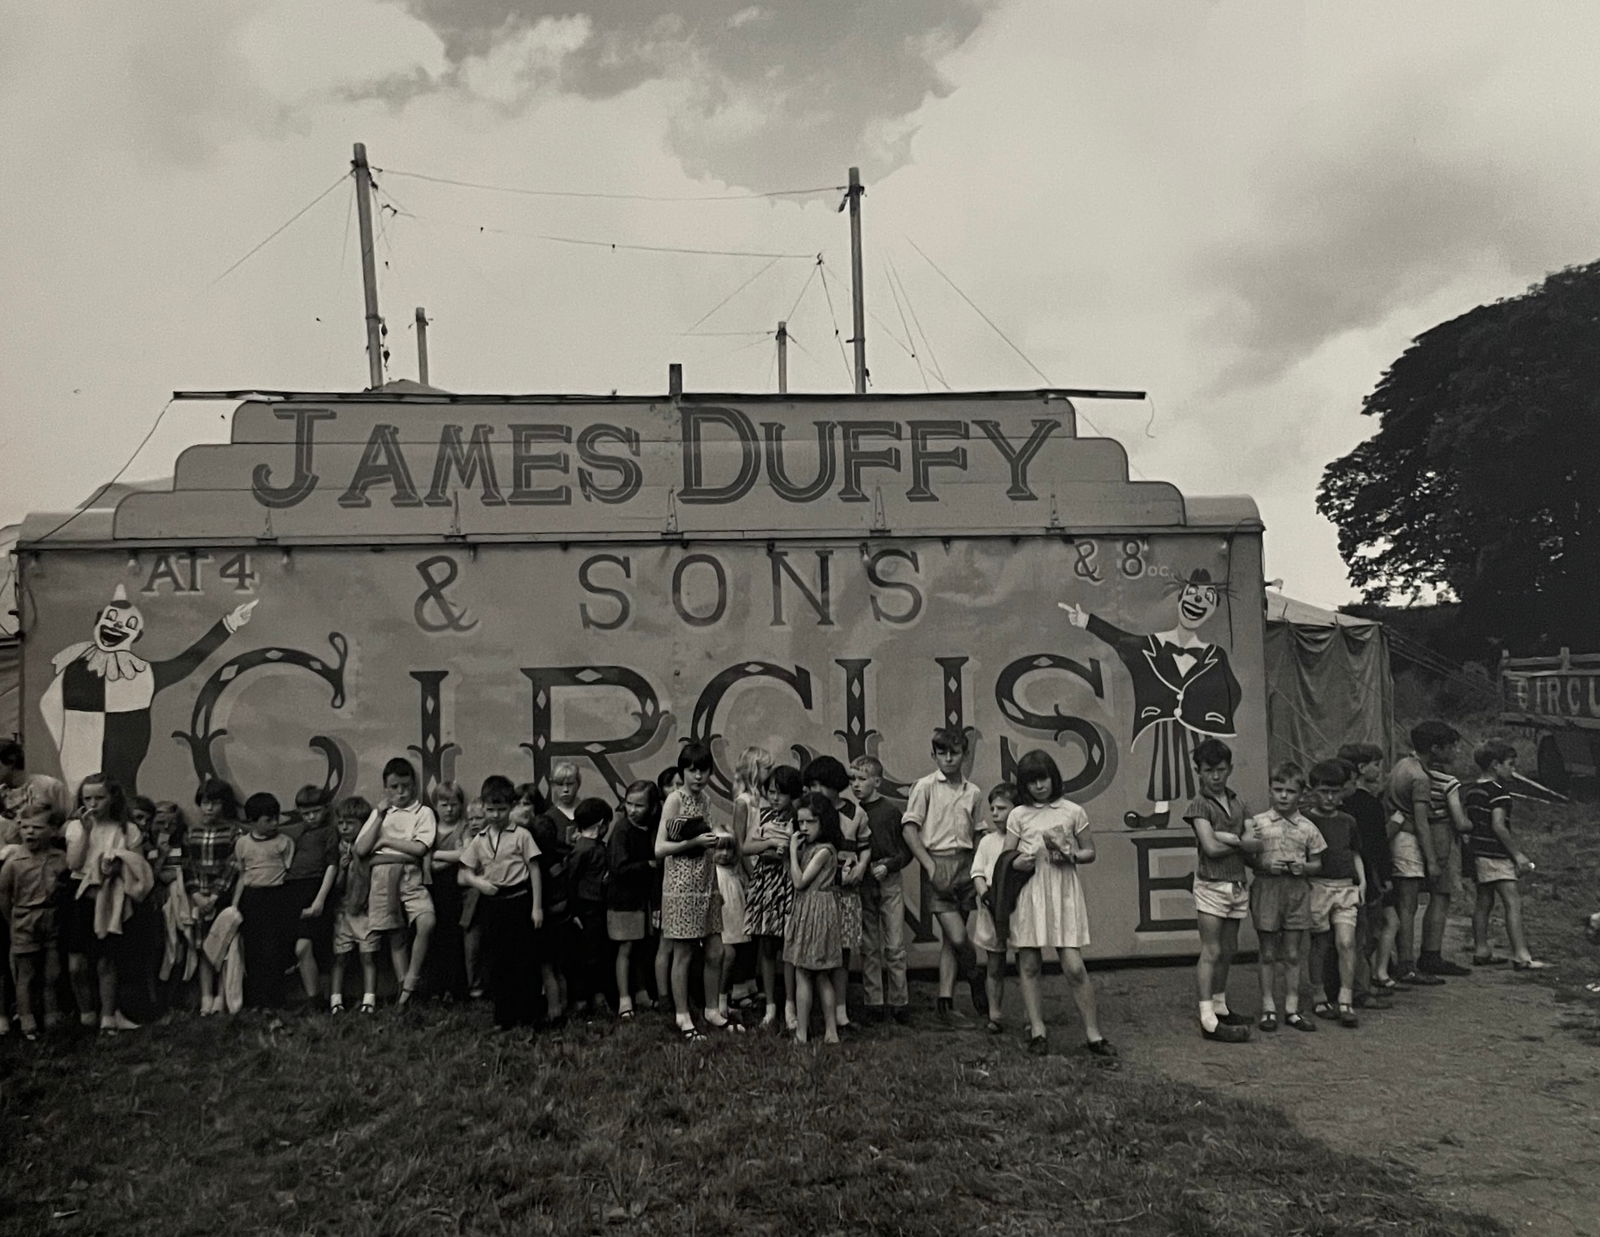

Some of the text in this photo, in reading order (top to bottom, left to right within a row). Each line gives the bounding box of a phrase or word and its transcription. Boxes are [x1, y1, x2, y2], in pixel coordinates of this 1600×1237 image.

[252, 406, 1061, 509] JAMES DUFFY
[139, 552, 259, 595] AT 4
[413, 547, 923, 632] & SONS
[1073, 540, 1106, 584] &
[172, 632, 1108, 824] CIRCUS
